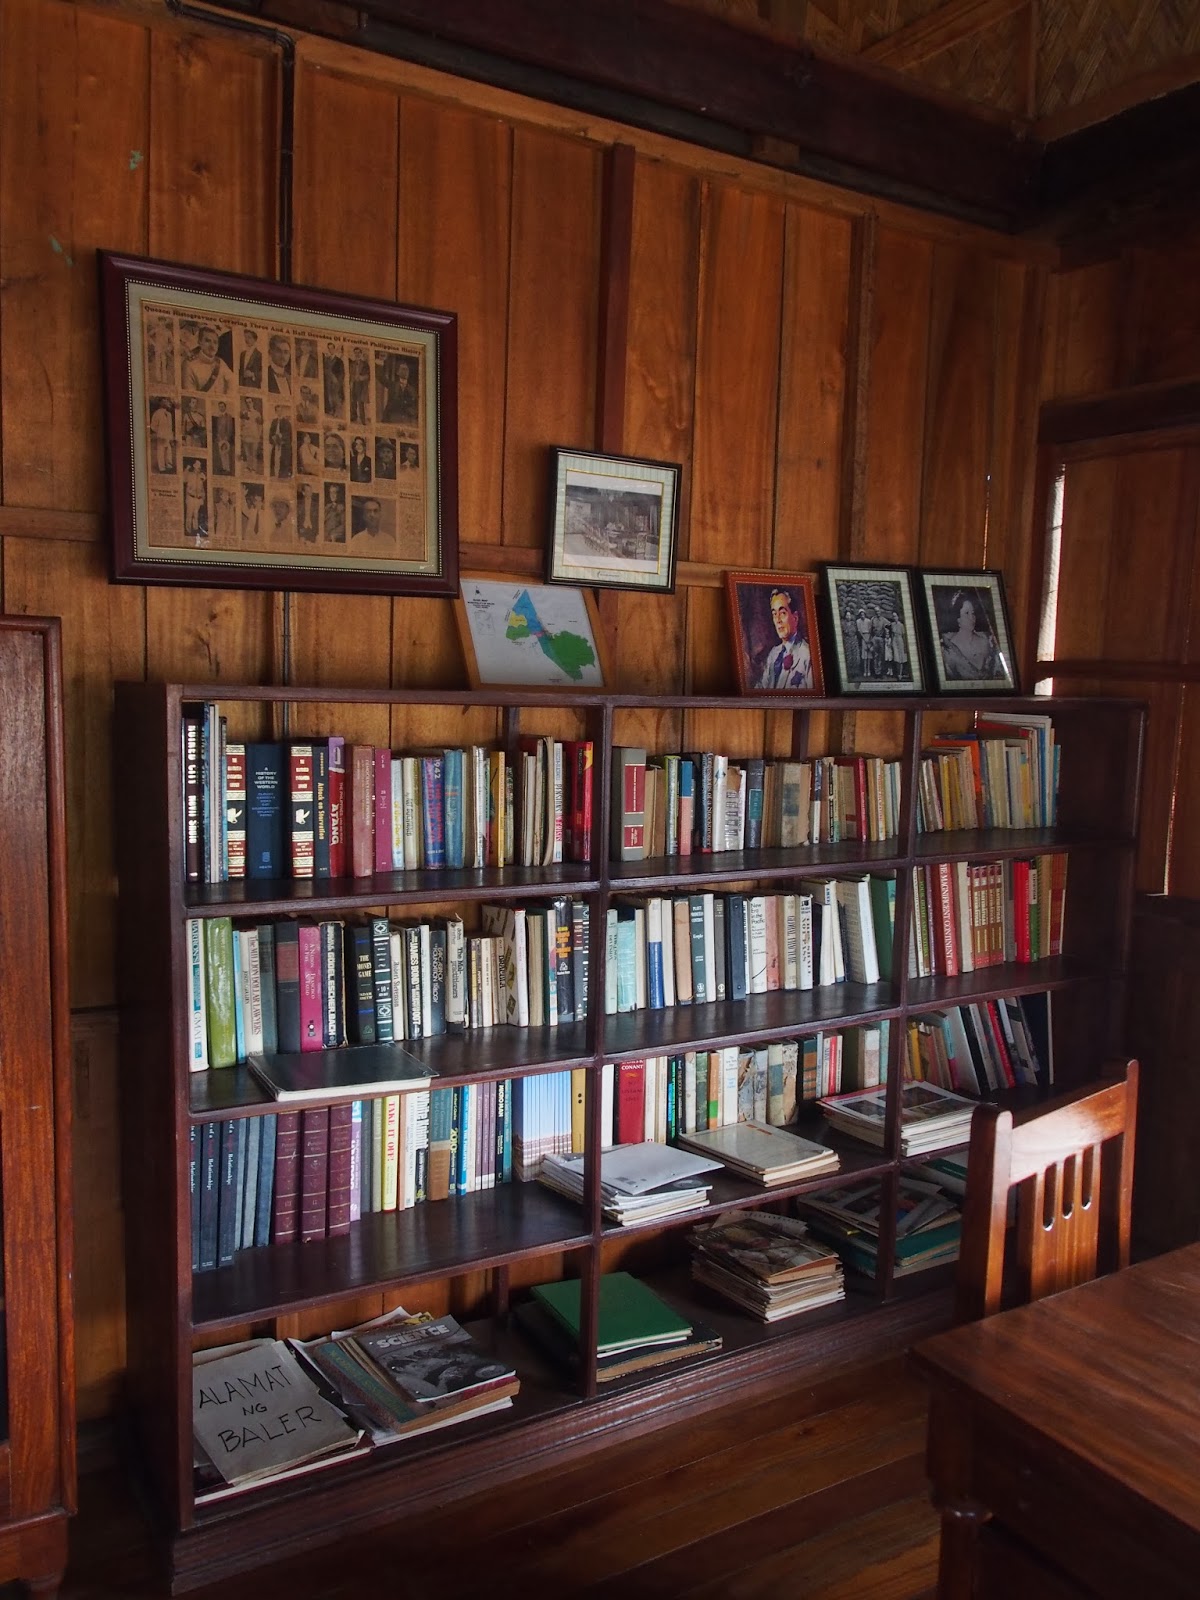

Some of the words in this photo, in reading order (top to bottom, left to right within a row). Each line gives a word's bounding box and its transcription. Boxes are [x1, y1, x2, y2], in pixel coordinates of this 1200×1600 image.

[144, 306, 170, 315] Quezon
[219, 316, 247, 328] Covering
[308, 332, 332, 340] Decades
[343, 337, 368, 346] Eventful
[370, 341, 399, 351] Philippine
[188, 725, 198, 760] RUINED
[188, 764, 198, 784] CITY
[330, 803, 339, 845] ATANG
[940, 875, 951, 919] MAGNIFICENT
[192, 920, 200, 963] BARRON'S
[250, 936, 258, 947] The
[943, 920, 953, 959] CONTINENT
[251, 948, 259, 975] MILLION
[252, 976, 260, 1002] DOLLAR
[194, 1011, 202, 1040] GMAT
[253, 1004, 261, 1035] LAWYERS
[417, 1094, 429, 1119] White
[388, 1129, 395, 1138] IT
[416, 1119, 429, 1149] Knight
[376, 1324, 450, 1348] SCIENCE
[199, 1365, 292, 1408] ALAMAT
[242, 1403, 268, 1416] NG
[218, 1406, 322, 1453] BALER
